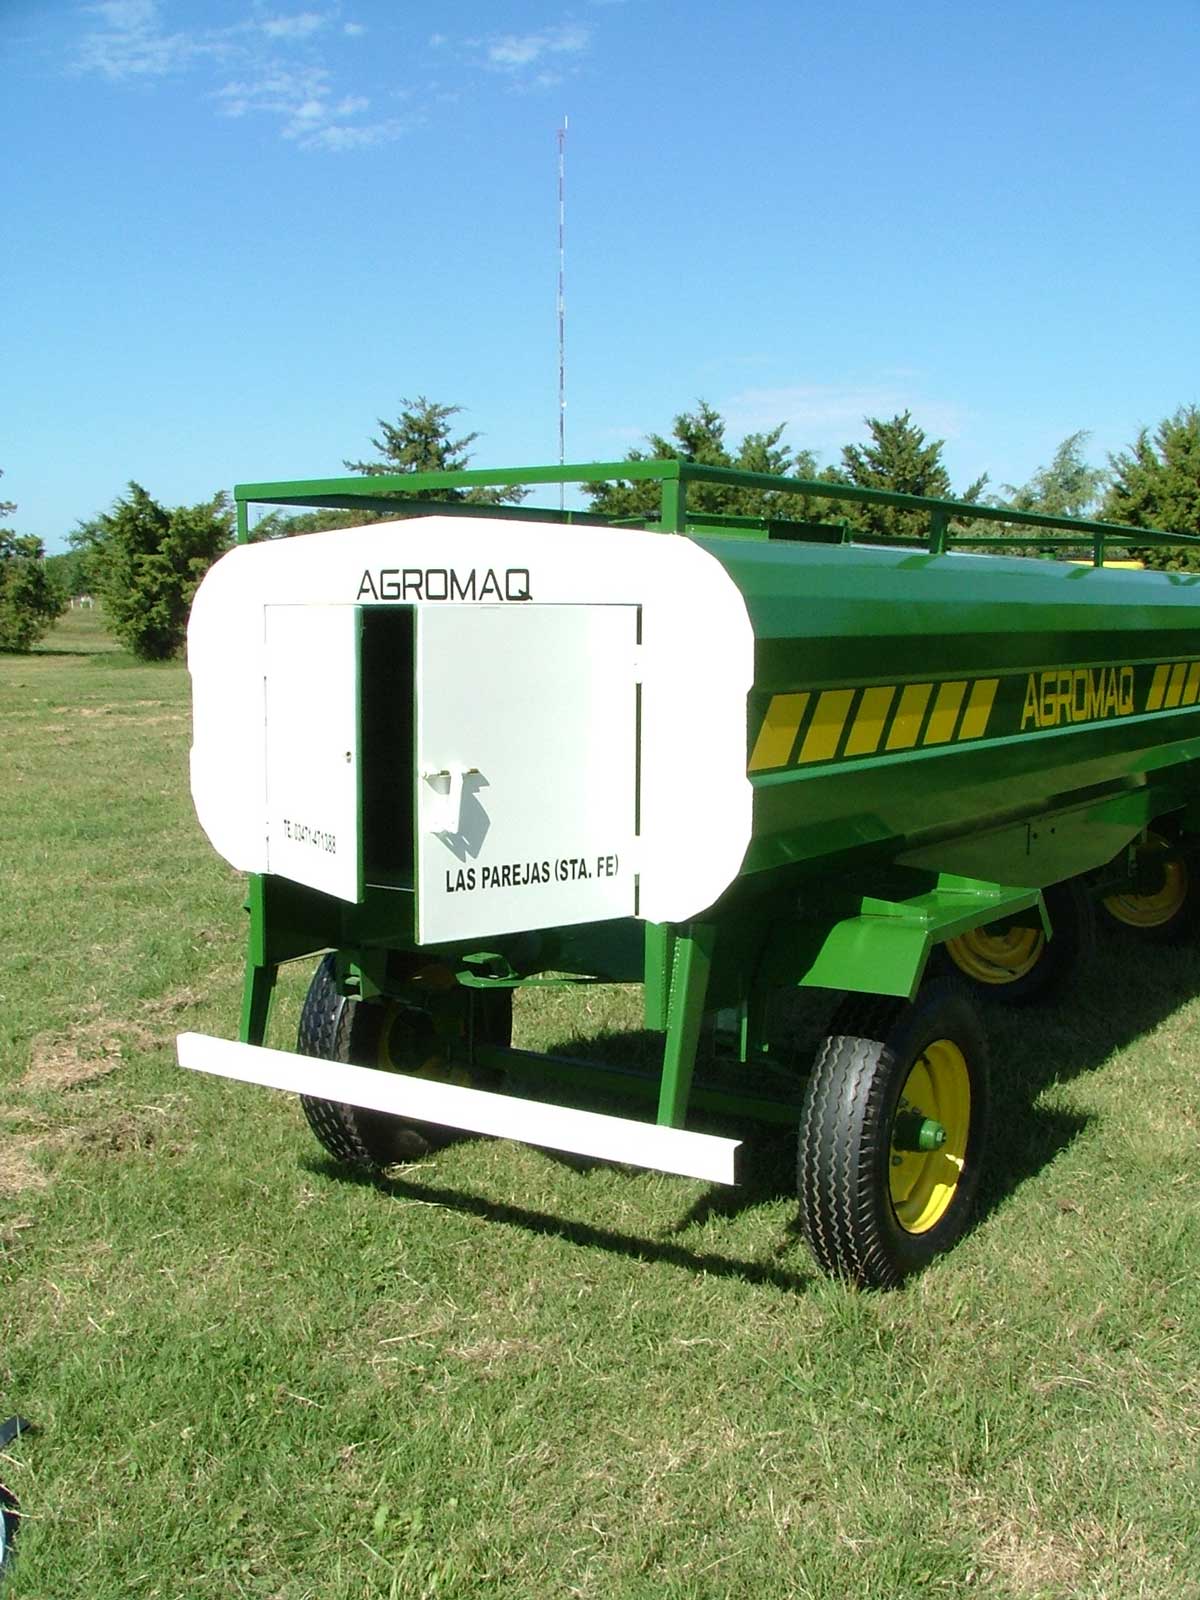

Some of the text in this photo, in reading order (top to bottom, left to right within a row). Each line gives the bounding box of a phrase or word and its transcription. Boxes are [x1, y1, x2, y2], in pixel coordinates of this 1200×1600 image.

[356, 568, 533, 601] AGROMAQ
[1020, 666, 1135, 731] AGROMAQ
[446, 853, 619, 893] LAS PAREJAS (STA. FE)
